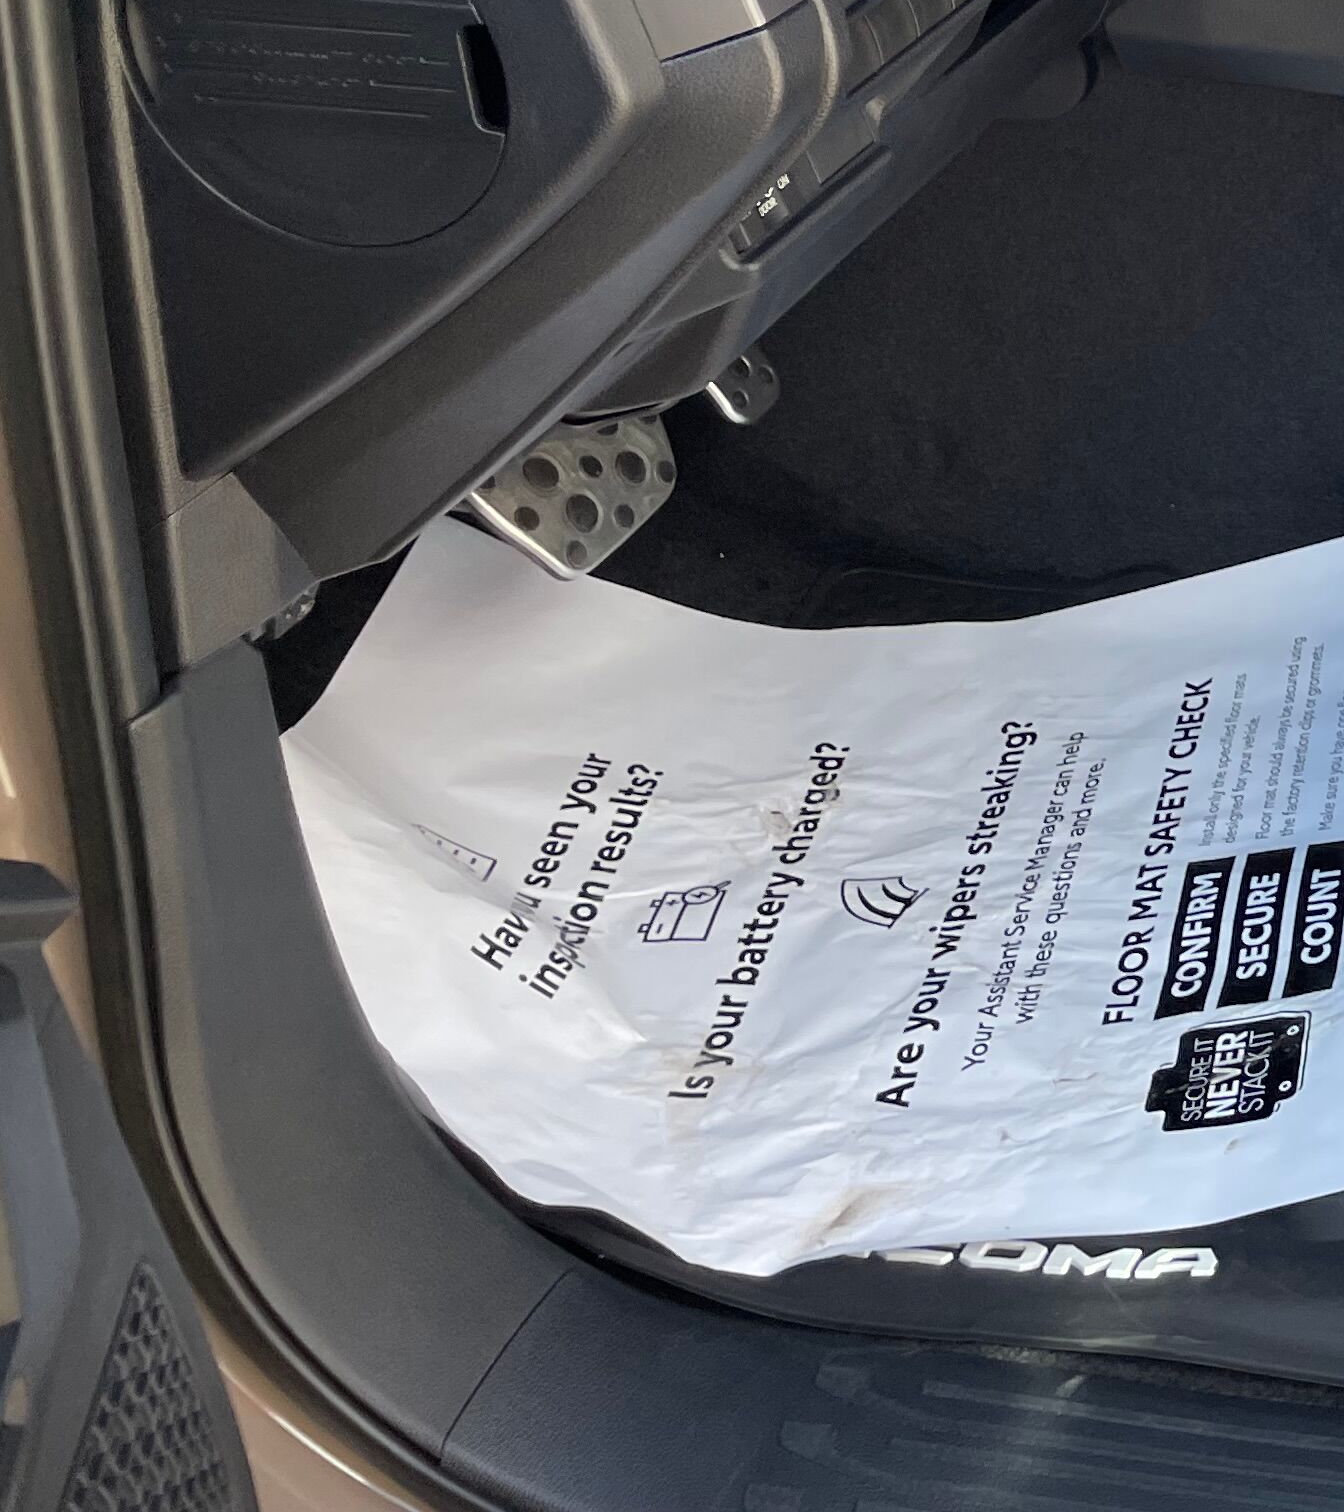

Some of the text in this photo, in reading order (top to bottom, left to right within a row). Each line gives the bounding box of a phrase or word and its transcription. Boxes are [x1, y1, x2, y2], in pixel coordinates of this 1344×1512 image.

[1209, 790, 1225, 814] only
[1232, 776, 1247, 792] for
[1240, 752, 1253, 774] your
[1268, 752, 1283, 786] should
[1326, 776, 1339, 800] sure
[1330, 755, 1344, 775] you
[470, 910, 529, 971] Hav
[524, 821, 579, 889] seen
[560, 751, 612, 815] your
[1102, 677, 1213, 1026] FLOOR MAT SAFETY CHECK
[1318, 800, 1336, 831] Make
[518, 879, 611, 1000] inspction
[591, 762, 664, 875] results?
[668, 741, 851, 1100] Is your battery charged?
[876, 721, 1038, 1108] Are your wipers streaking?
[961, 731, 1089, 1071] Your Assistant Service Manager can help
[1015, 757, 1107, 1024] with these questions and more.
[1235, 872, 1280, 980] SECURE
[1301, 869, 1341, 965] COUNT
[1171, 872, 1223, 998] CONFIRM
[1181, 1039, 1215, 1122] SECURE IT
[1204, 1030, 1249, 1119] NEVER
[1238, 1030, 1275, 1114] STACK IT
